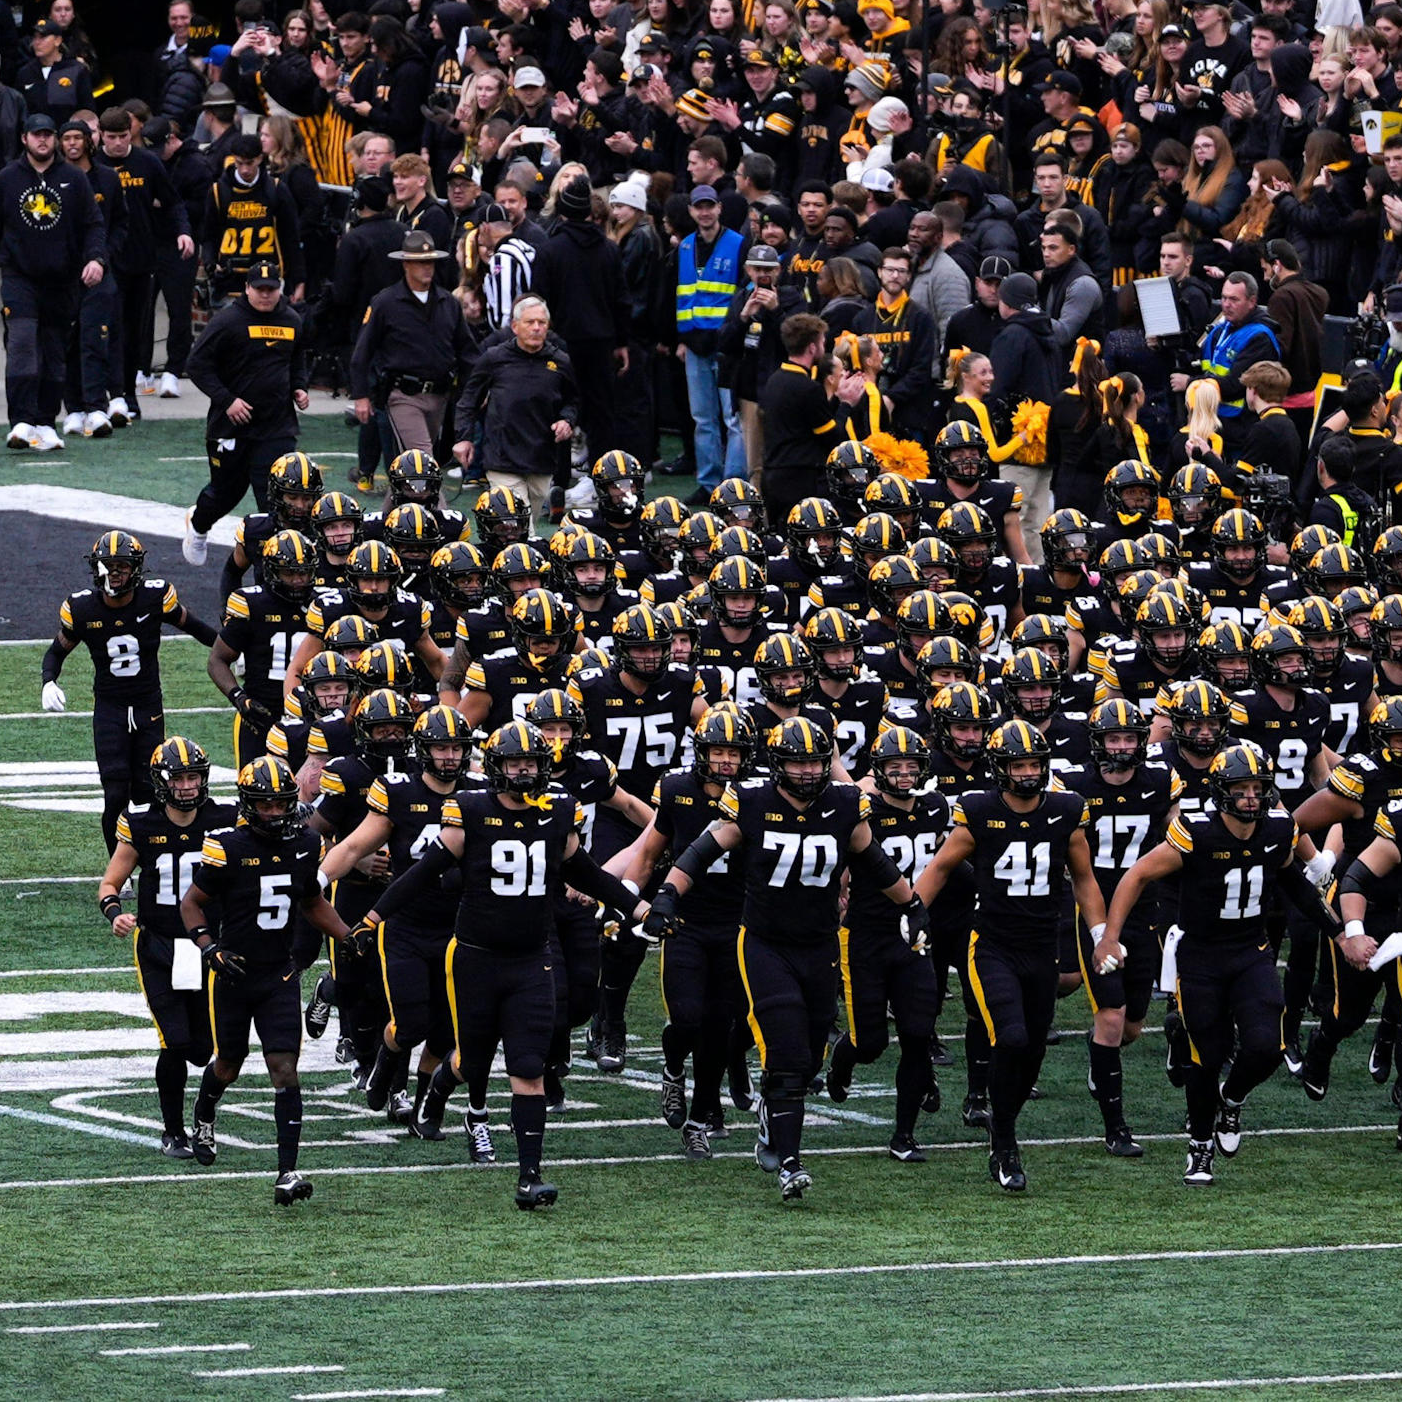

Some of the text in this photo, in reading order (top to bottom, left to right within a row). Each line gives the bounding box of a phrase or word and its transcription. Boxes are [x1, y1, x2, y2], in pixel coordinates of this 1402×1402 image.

[1190, 58, 1227, 78] IOWA
[222, 226, 277, 256] 012
[259, 327, 286, 338] IOWA
[106, 634, 141, 678] 8
[605, 712, 675, 770] 75
[1276, 739, 1307, 789] 9
[489, 839, 547, 897] 91
[761, 832, 839, 888] 70
[992, 840, 1051, 897] 41
[1093, 814, 1151, 869] 17
[155, 851, 200, 906] 10
[256, 873, 291, 930] 5
[1219, 864, 1265, 919] 11
